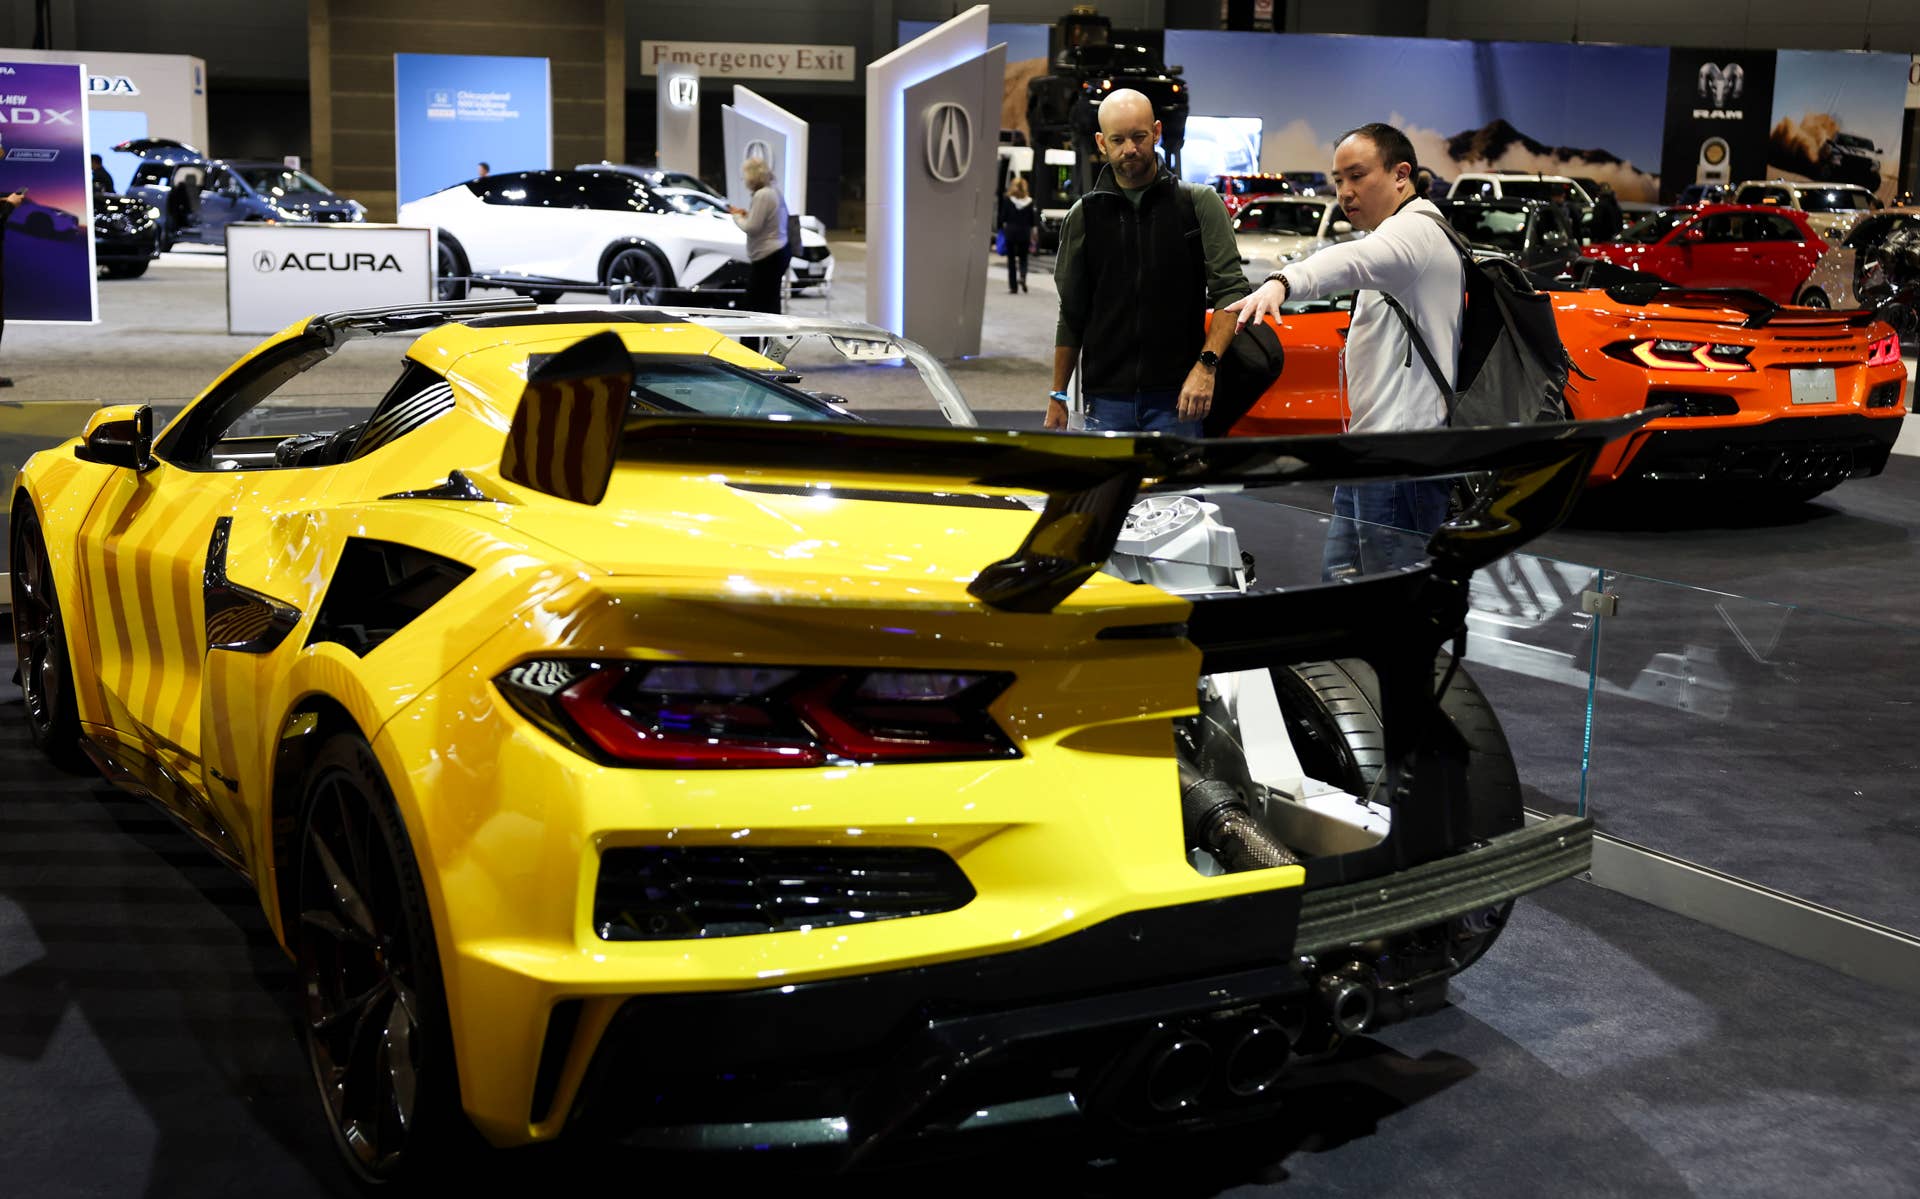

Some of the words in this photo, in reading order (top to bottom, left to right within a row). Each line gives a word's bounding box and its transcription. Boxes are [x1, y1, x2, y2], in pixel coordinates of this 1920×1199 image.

[652, 45, 790, 74] Emergency
[797, 49, 845, 70] Exit
[1693, 109, 1743, 119] RAM
[279, 252, 403, 272] ACURA
